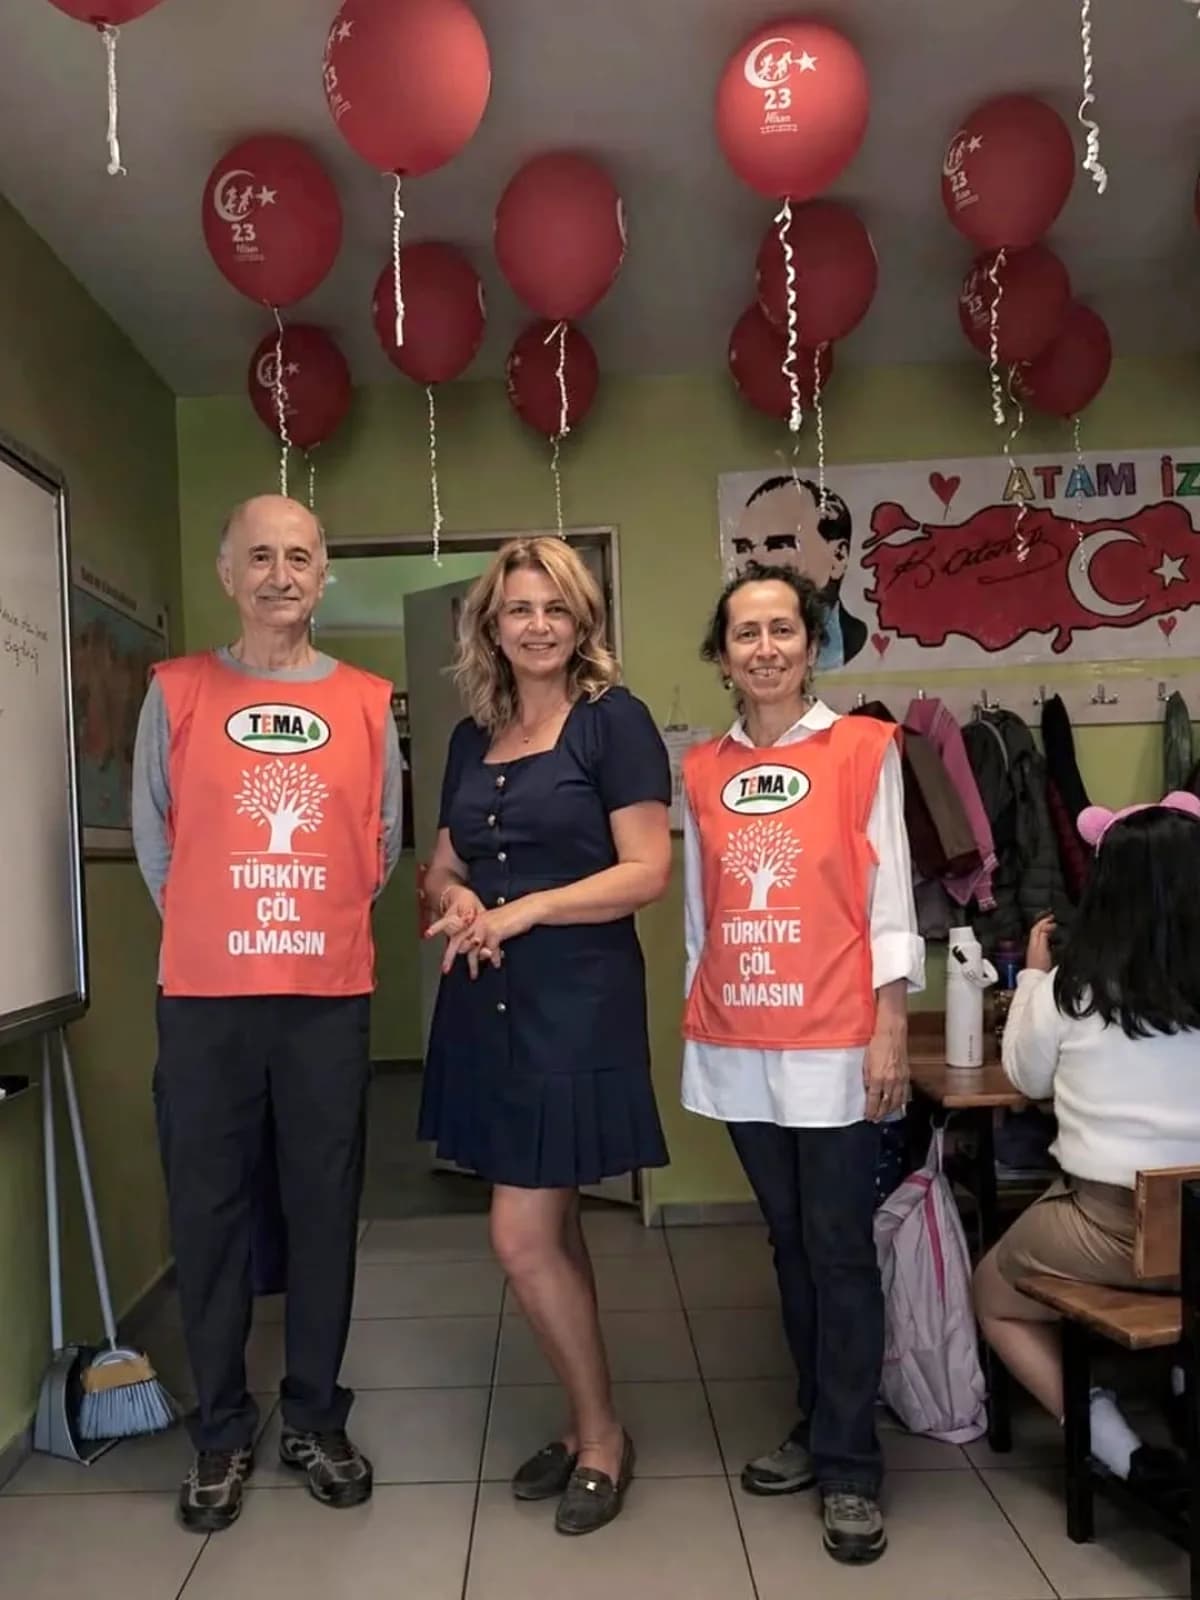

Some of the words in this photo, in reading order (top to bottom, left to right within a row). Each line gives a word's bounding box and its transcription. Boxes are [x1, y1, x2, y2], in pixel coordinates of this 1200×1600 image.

[764, 88, 792, 111] 23
[950, 170, 968, 192] 23
[231, 223, 256, 242] 23
[1003, 463, 1137, 501] ATAM
[249, 713, 305, 735] TEMA
[740, 775, 785, 797] TEMA
[230, 858, 326, 891] TÜRKİYE
[257, 892, 301, 929] ÇÖL
[722, 915, 801, 945] TÜRKİYE
[228, 931, 326, 957] OLMASIN
[739, 947, 776, 982] ÇÖL
[723, 983, 804, 1008] OLMASIN
